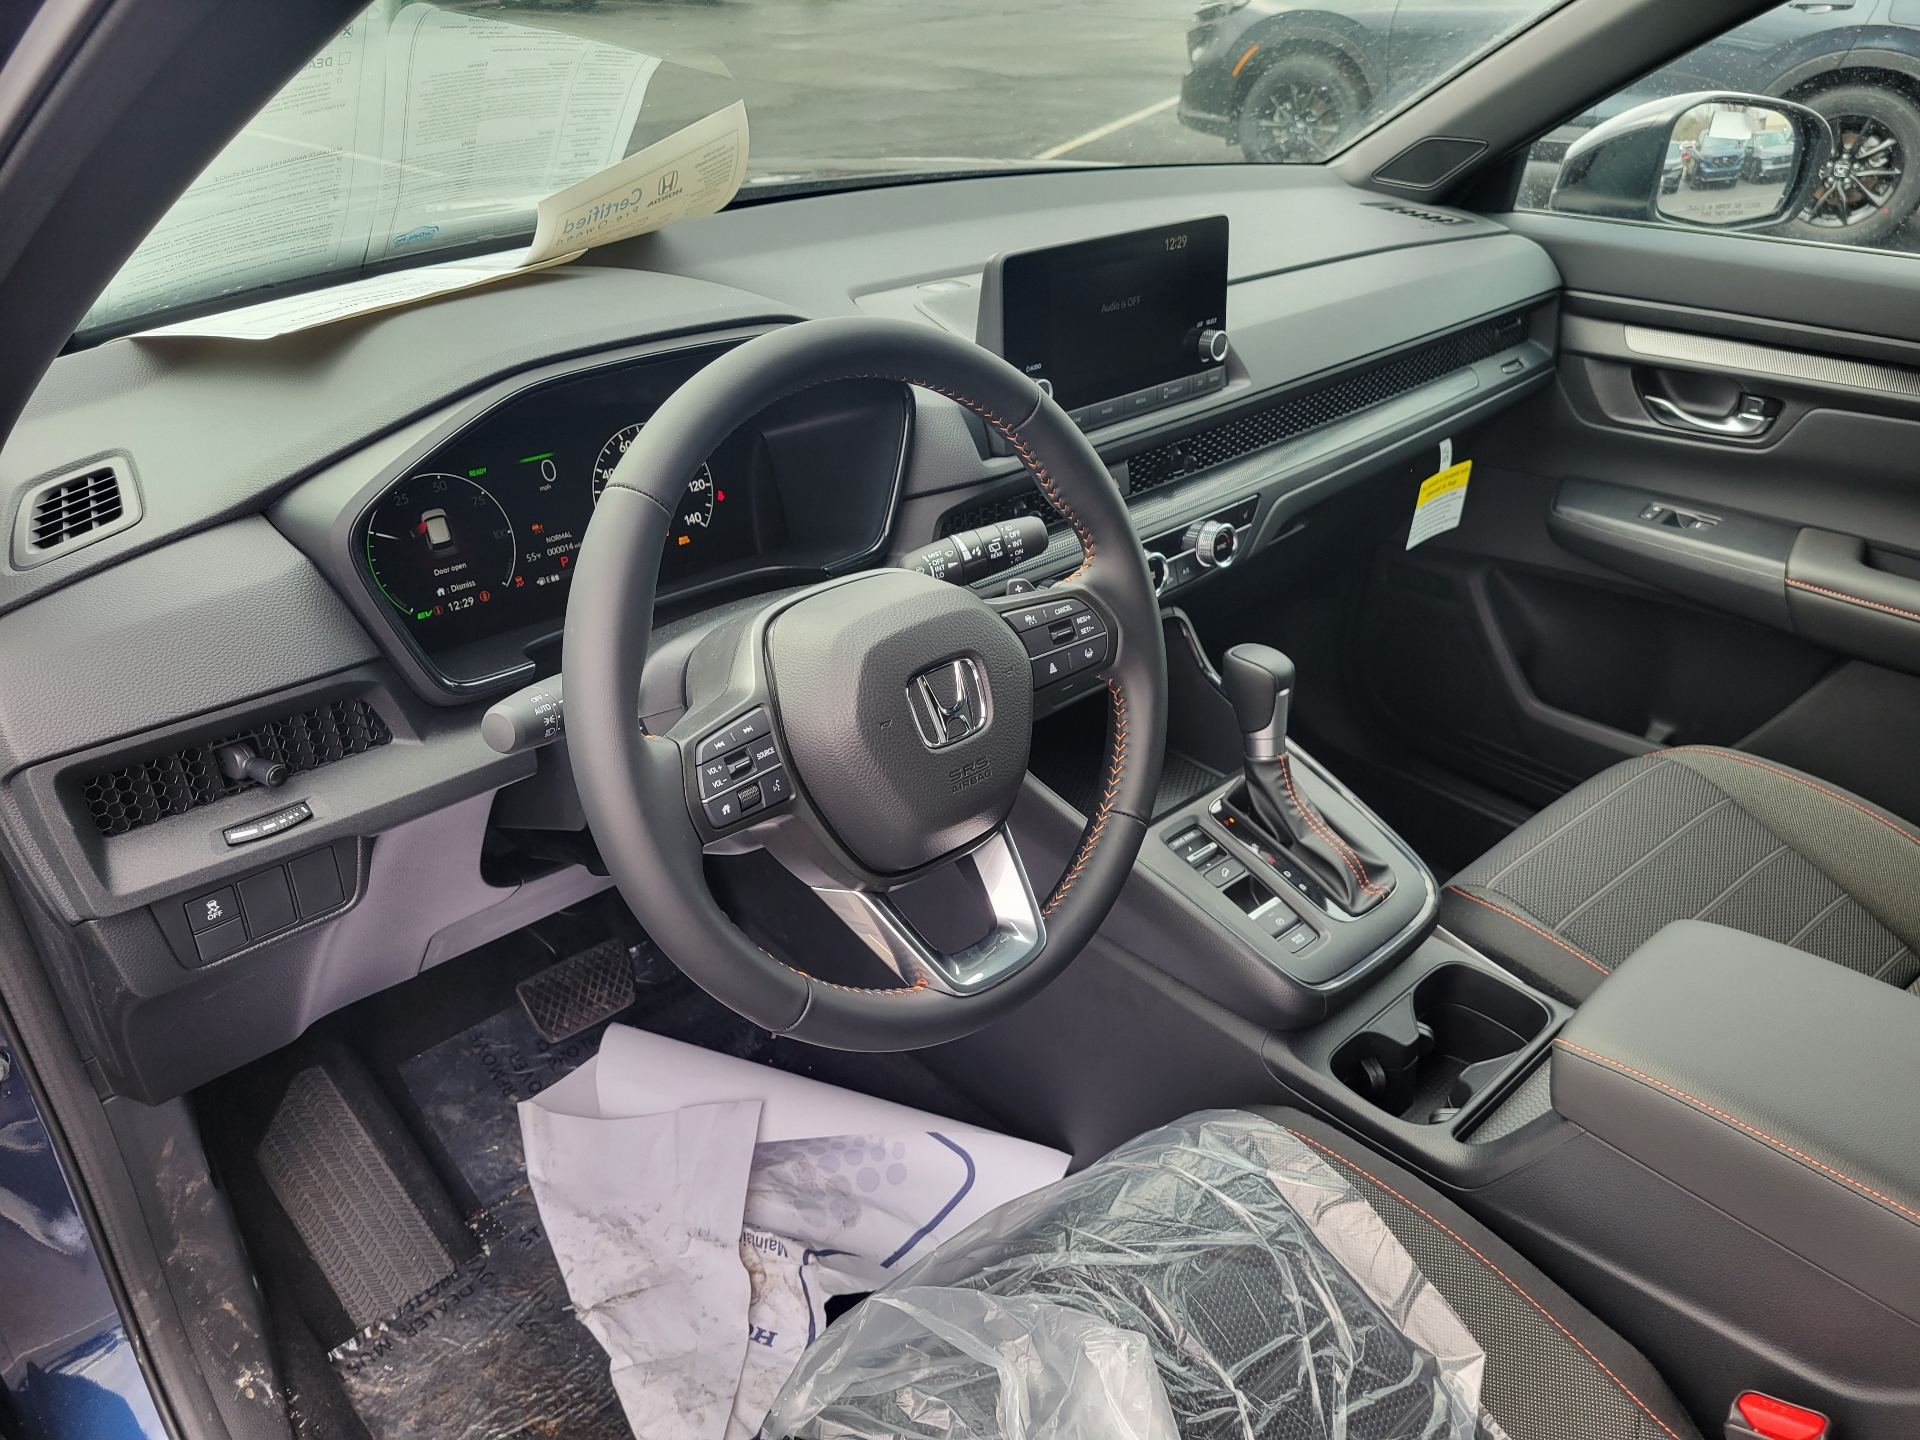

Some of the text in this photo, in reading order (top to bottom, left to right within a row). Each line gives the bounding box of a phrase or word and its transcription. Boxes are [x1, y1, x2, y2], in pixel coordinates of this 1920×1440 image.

[1164, 235, 1188, 251] 12:29
[1101, 301, 1120, 313] Audio
[1127, 295, 1142, 308] OFF
[469, 467, 487, 477] READY
[541, 459, 557, 482] 0
[433, 480, 448, 493] 50
[540, 484, 552, 492] mph
[688, 479, 706, 492] 120
[684, 511, 702, 525] 140
[545, 531, 572, 543] NORMAL
[1009, 529, 1021, 538] OFF
[546, 542, 574, 556] 000014
[1012, 539, 1023, 548] INT
[928, 550, 942, 559] MIST
[990, 551, 1004, 560] REAR
[1014, 548, 1024, 556] ON
[560, 556, 569, 568] P
[932, 557, 945, 566] OFF
[433, 562, 467, 577] Door open
[934, 565, 945, 573] INT
[936, 571, 945, 579] LO
[450, 580, 476, 593] Dismiss
[448, 596, 475, 612] 12:29
[1054, 604, 1073, 615] CANCEL
[417, 609, 433, 620] EV
[530, 694, 543, 703] OFF
[534, 703, 552, 716] AUTO
[756, 745, 776, 761] SOURCE
[949, 756, 990, 783] SRS
[950, 769, 993, 794] AIRBAG
[207, 909, 223, 921] OFF
[547, 1032, 601, 1072] PROTE
[509, 1049, 543, 1094] OVER
[402, 1285, 475, 1339] DEALER
[345, 1338, 392, 1377] MUS
